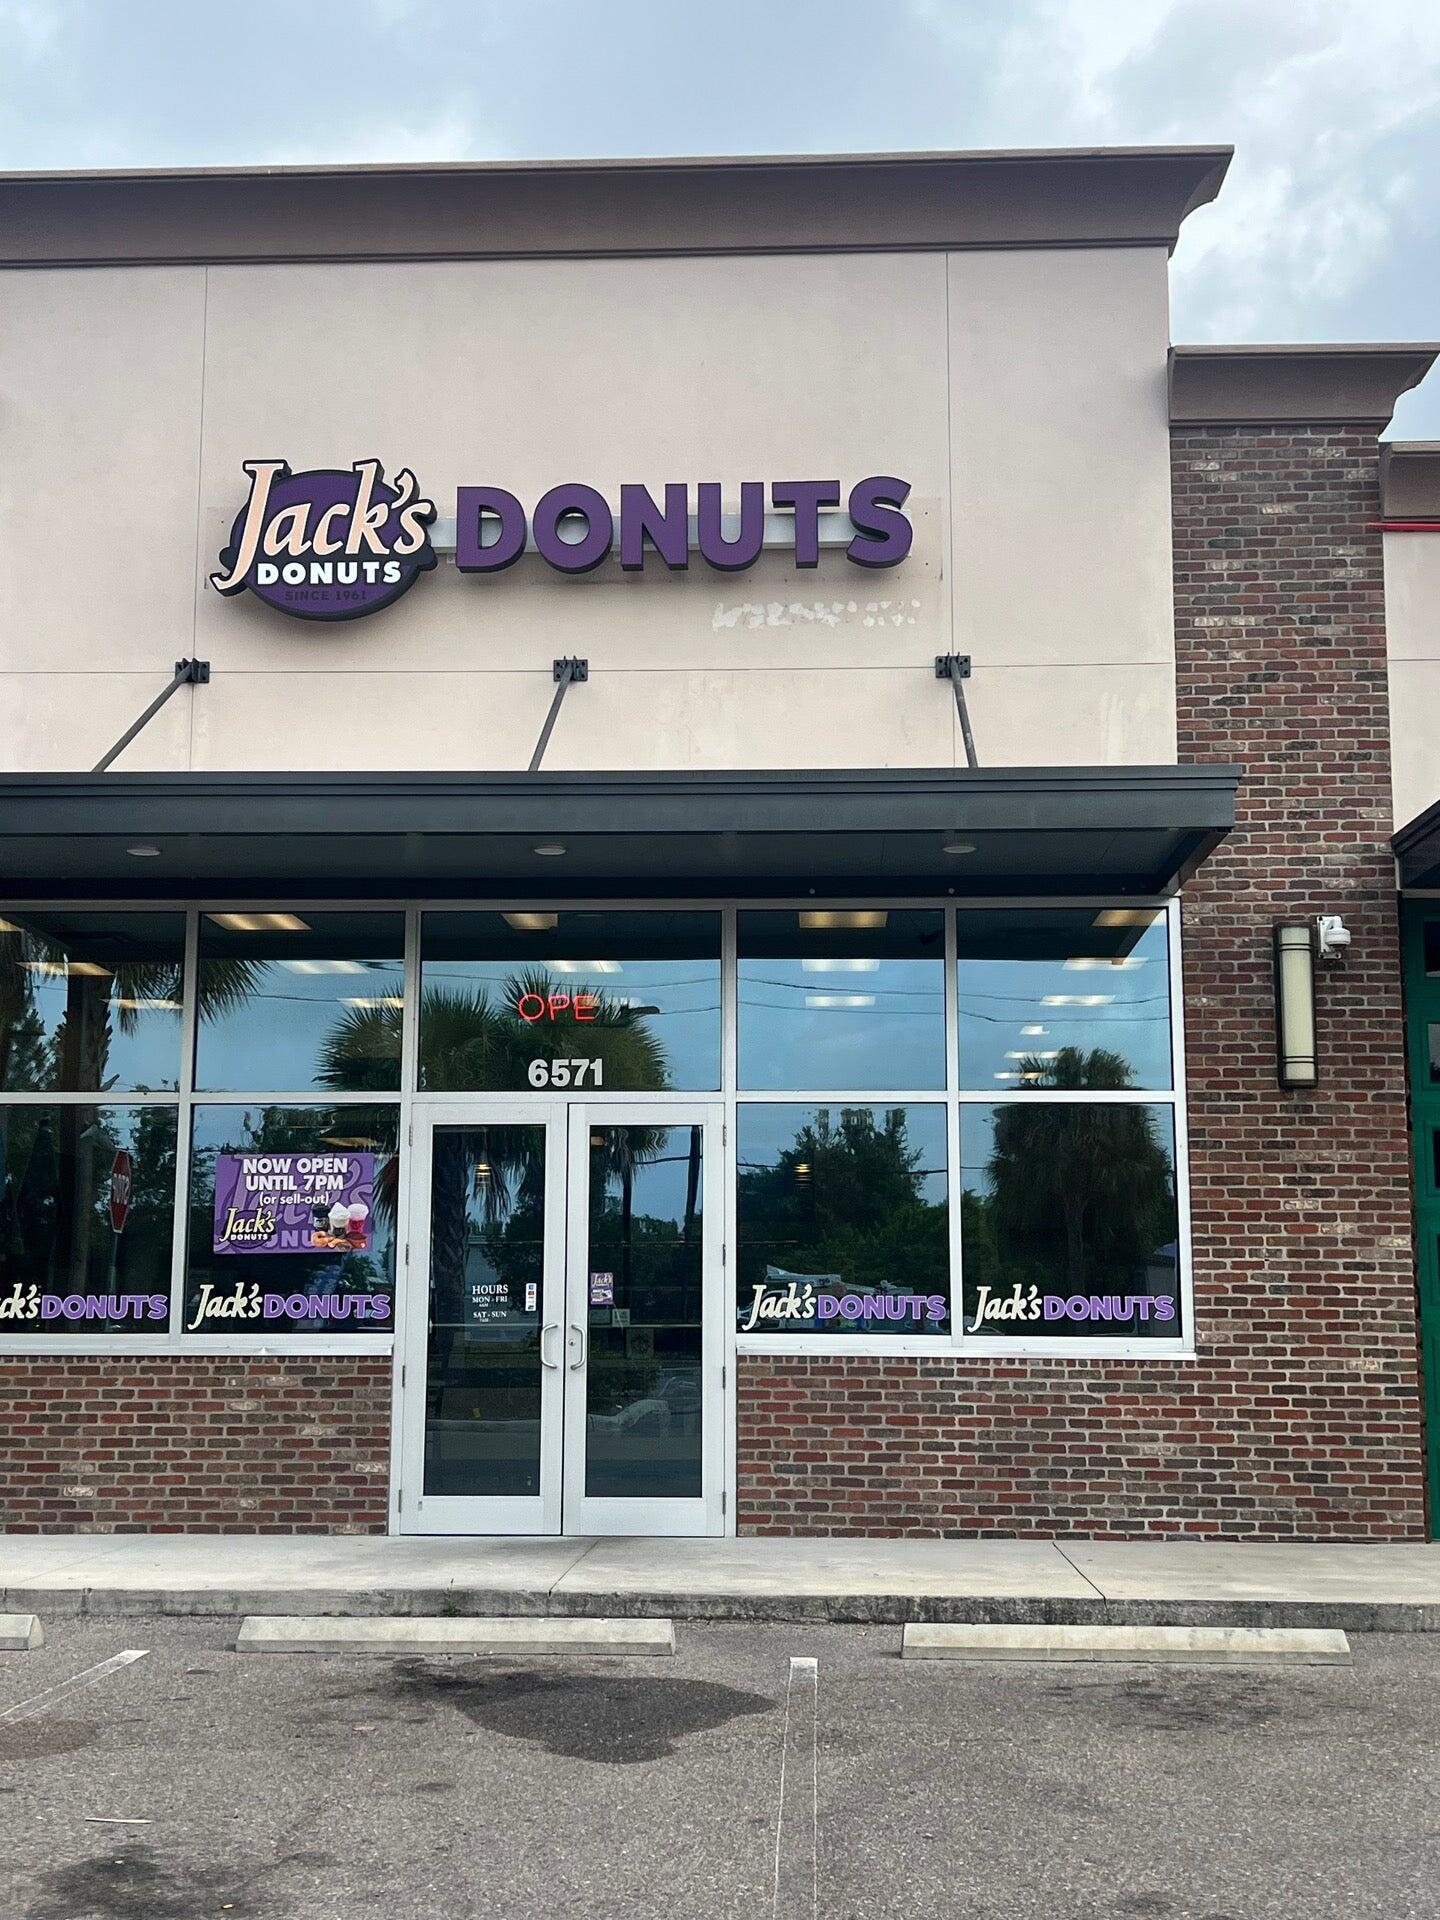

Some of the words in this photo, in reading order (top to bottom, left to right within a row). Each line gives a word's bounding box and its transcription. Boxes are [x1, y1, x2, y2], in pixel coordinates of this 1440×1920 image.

[210, 461, 433, 591] Jack's
[455, 475, 914, 575] DONUTS
[256, 560, 402, 586] DONUTS
[285, 590, 330, 602] SINCE
[335, 590, 367, 601] 1961
[527, 1058, 603, 1088] 6571
[242, 1158, 293, 1174] NOW
[296, 1157, 348, 1174] OPEN
[245, 1175, 298, 1191] UNTIL
[303, 1174, 345, 1191] 7PM
[259, 1192, 279, 1206] (or
[279, 1191, 330, 1206] sell-out)
[219, 1207, 276, 1242] Jack's
[230, 1233, 268, 1241] DONUTS
[472, 1284, 509, 1295] HOURS
[41, 1294, 169, 1320] DONUTS
[187, 1282, 263, 1331] Jack's
[263, 1294, 391, 1320] DONUTS
[741, 1282, 817, 1331] Jack's
[817, 1294, 947, 1321] DONUTS
[967, 1283, 1043, 1333] Jack's
[1043, 1295, 1176, 1321] DONUTS
